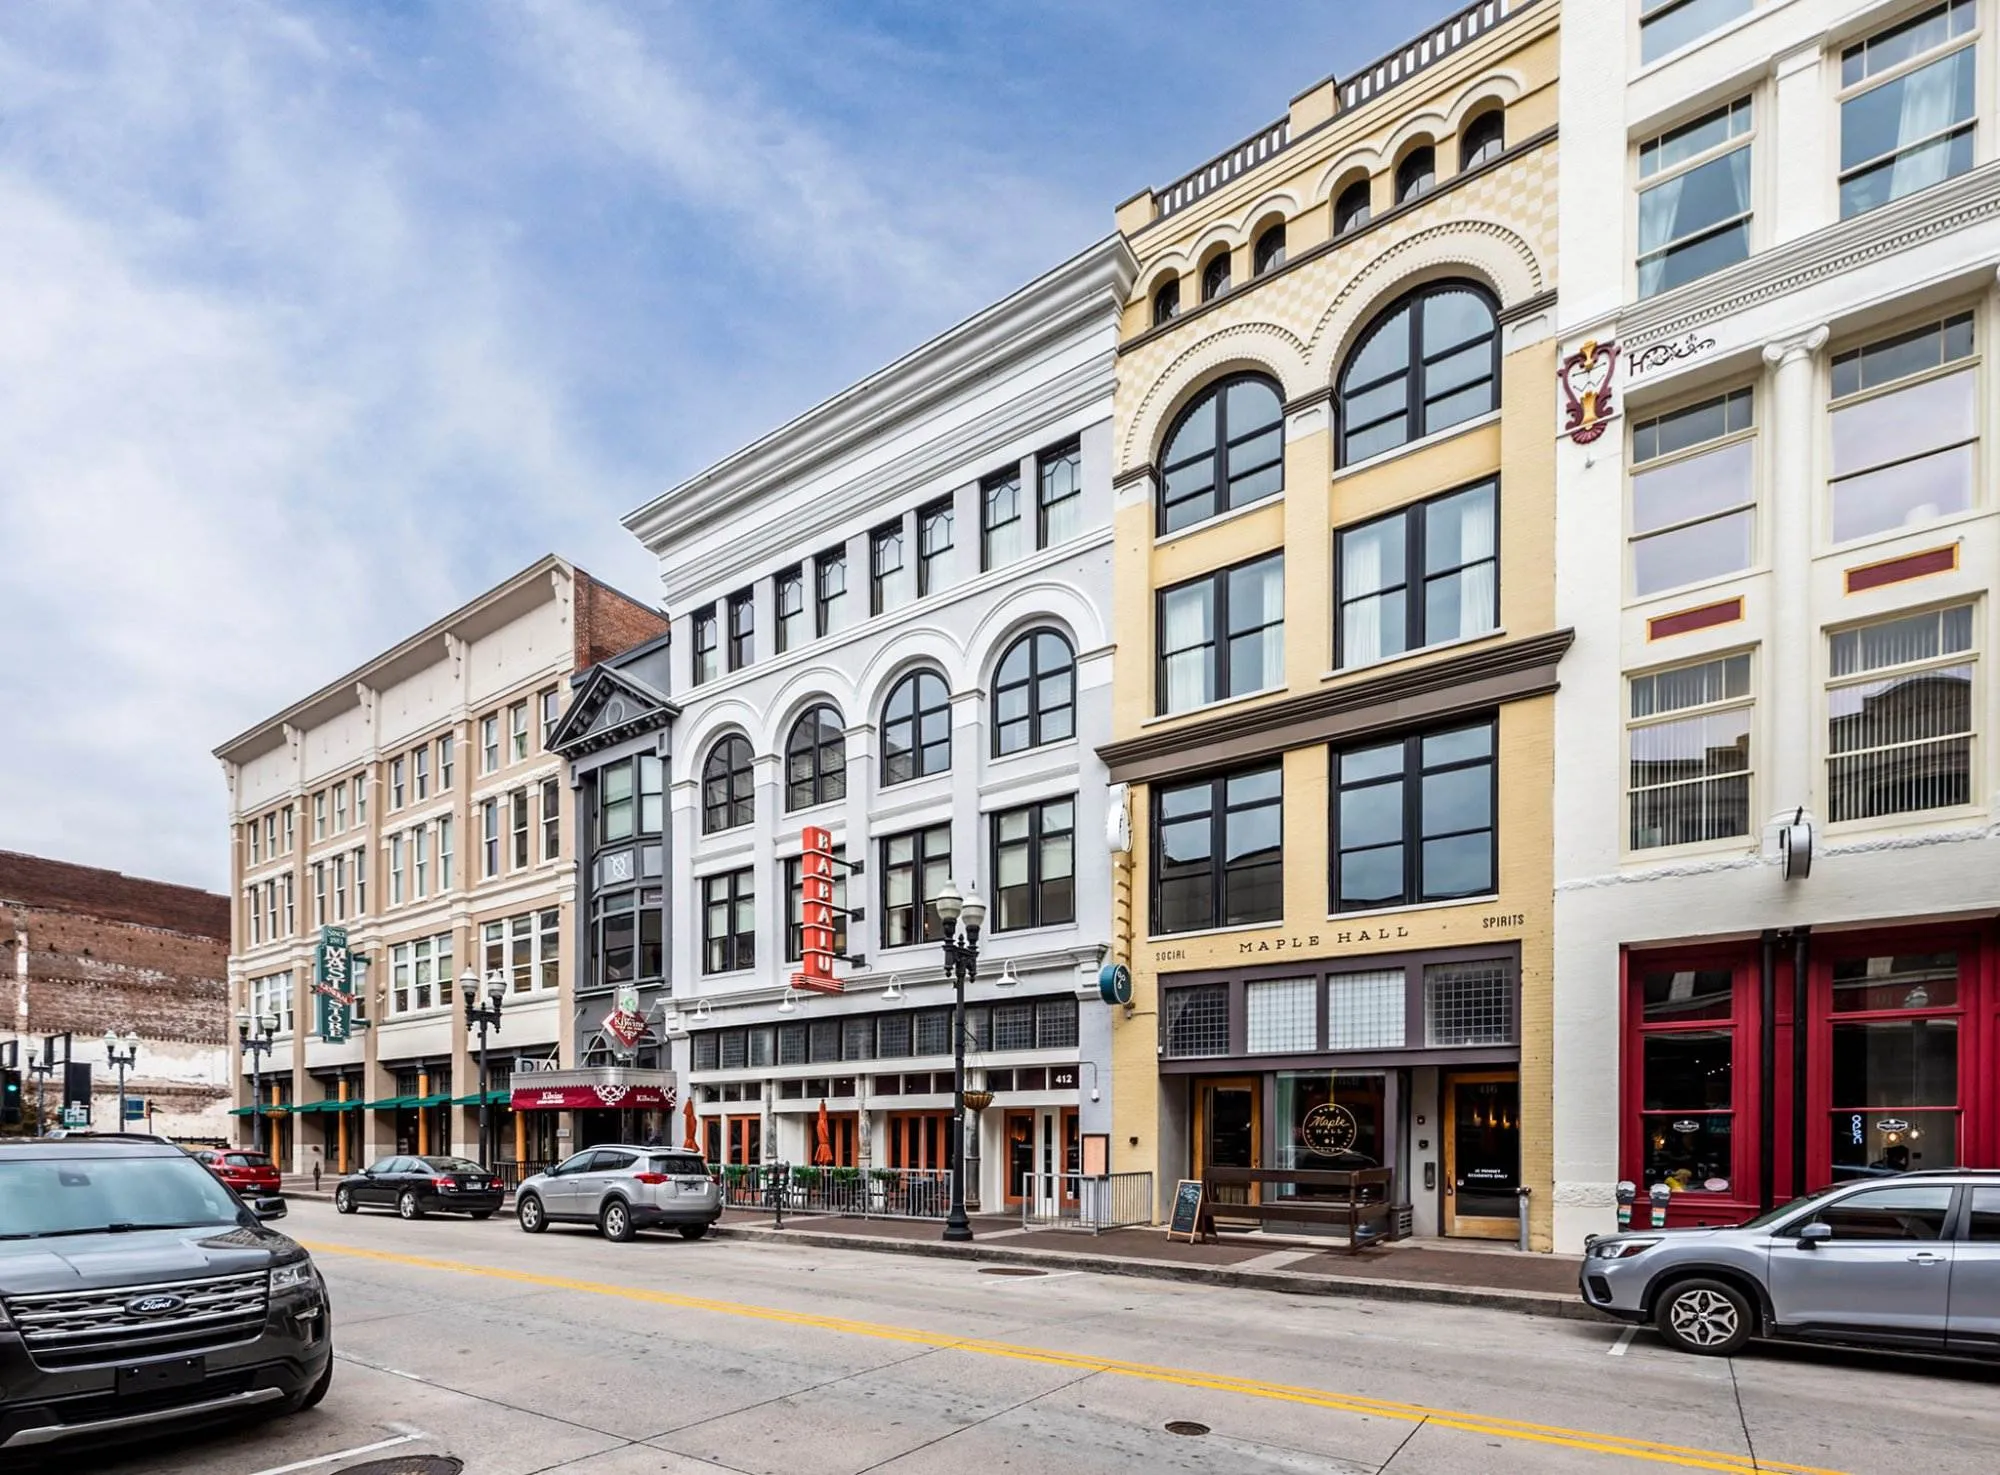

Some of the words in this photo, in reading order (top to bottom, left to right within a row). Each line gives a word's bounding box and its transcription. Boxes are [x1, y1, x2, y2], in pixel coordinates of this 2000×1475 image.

[817, 832, 831, 972] BABALU
[1155, 949, 1186, 961] SOCIAL
[1239, 935, 1320, 953] MAPLE
[1337, 926, 1410, 943] HALL
[1482, 914, 1525, 929] SPIRITS
[325, 945, 347, 990] MAST
[327, 1000, 346, 1037] STORE
[1056, 1074, 1073, 1083] 412
[1308, 1115, 1351, 1130] Maple
[1852, 1114, 1863, 1144] open
[141, 1298, 172, 1311] Ford
